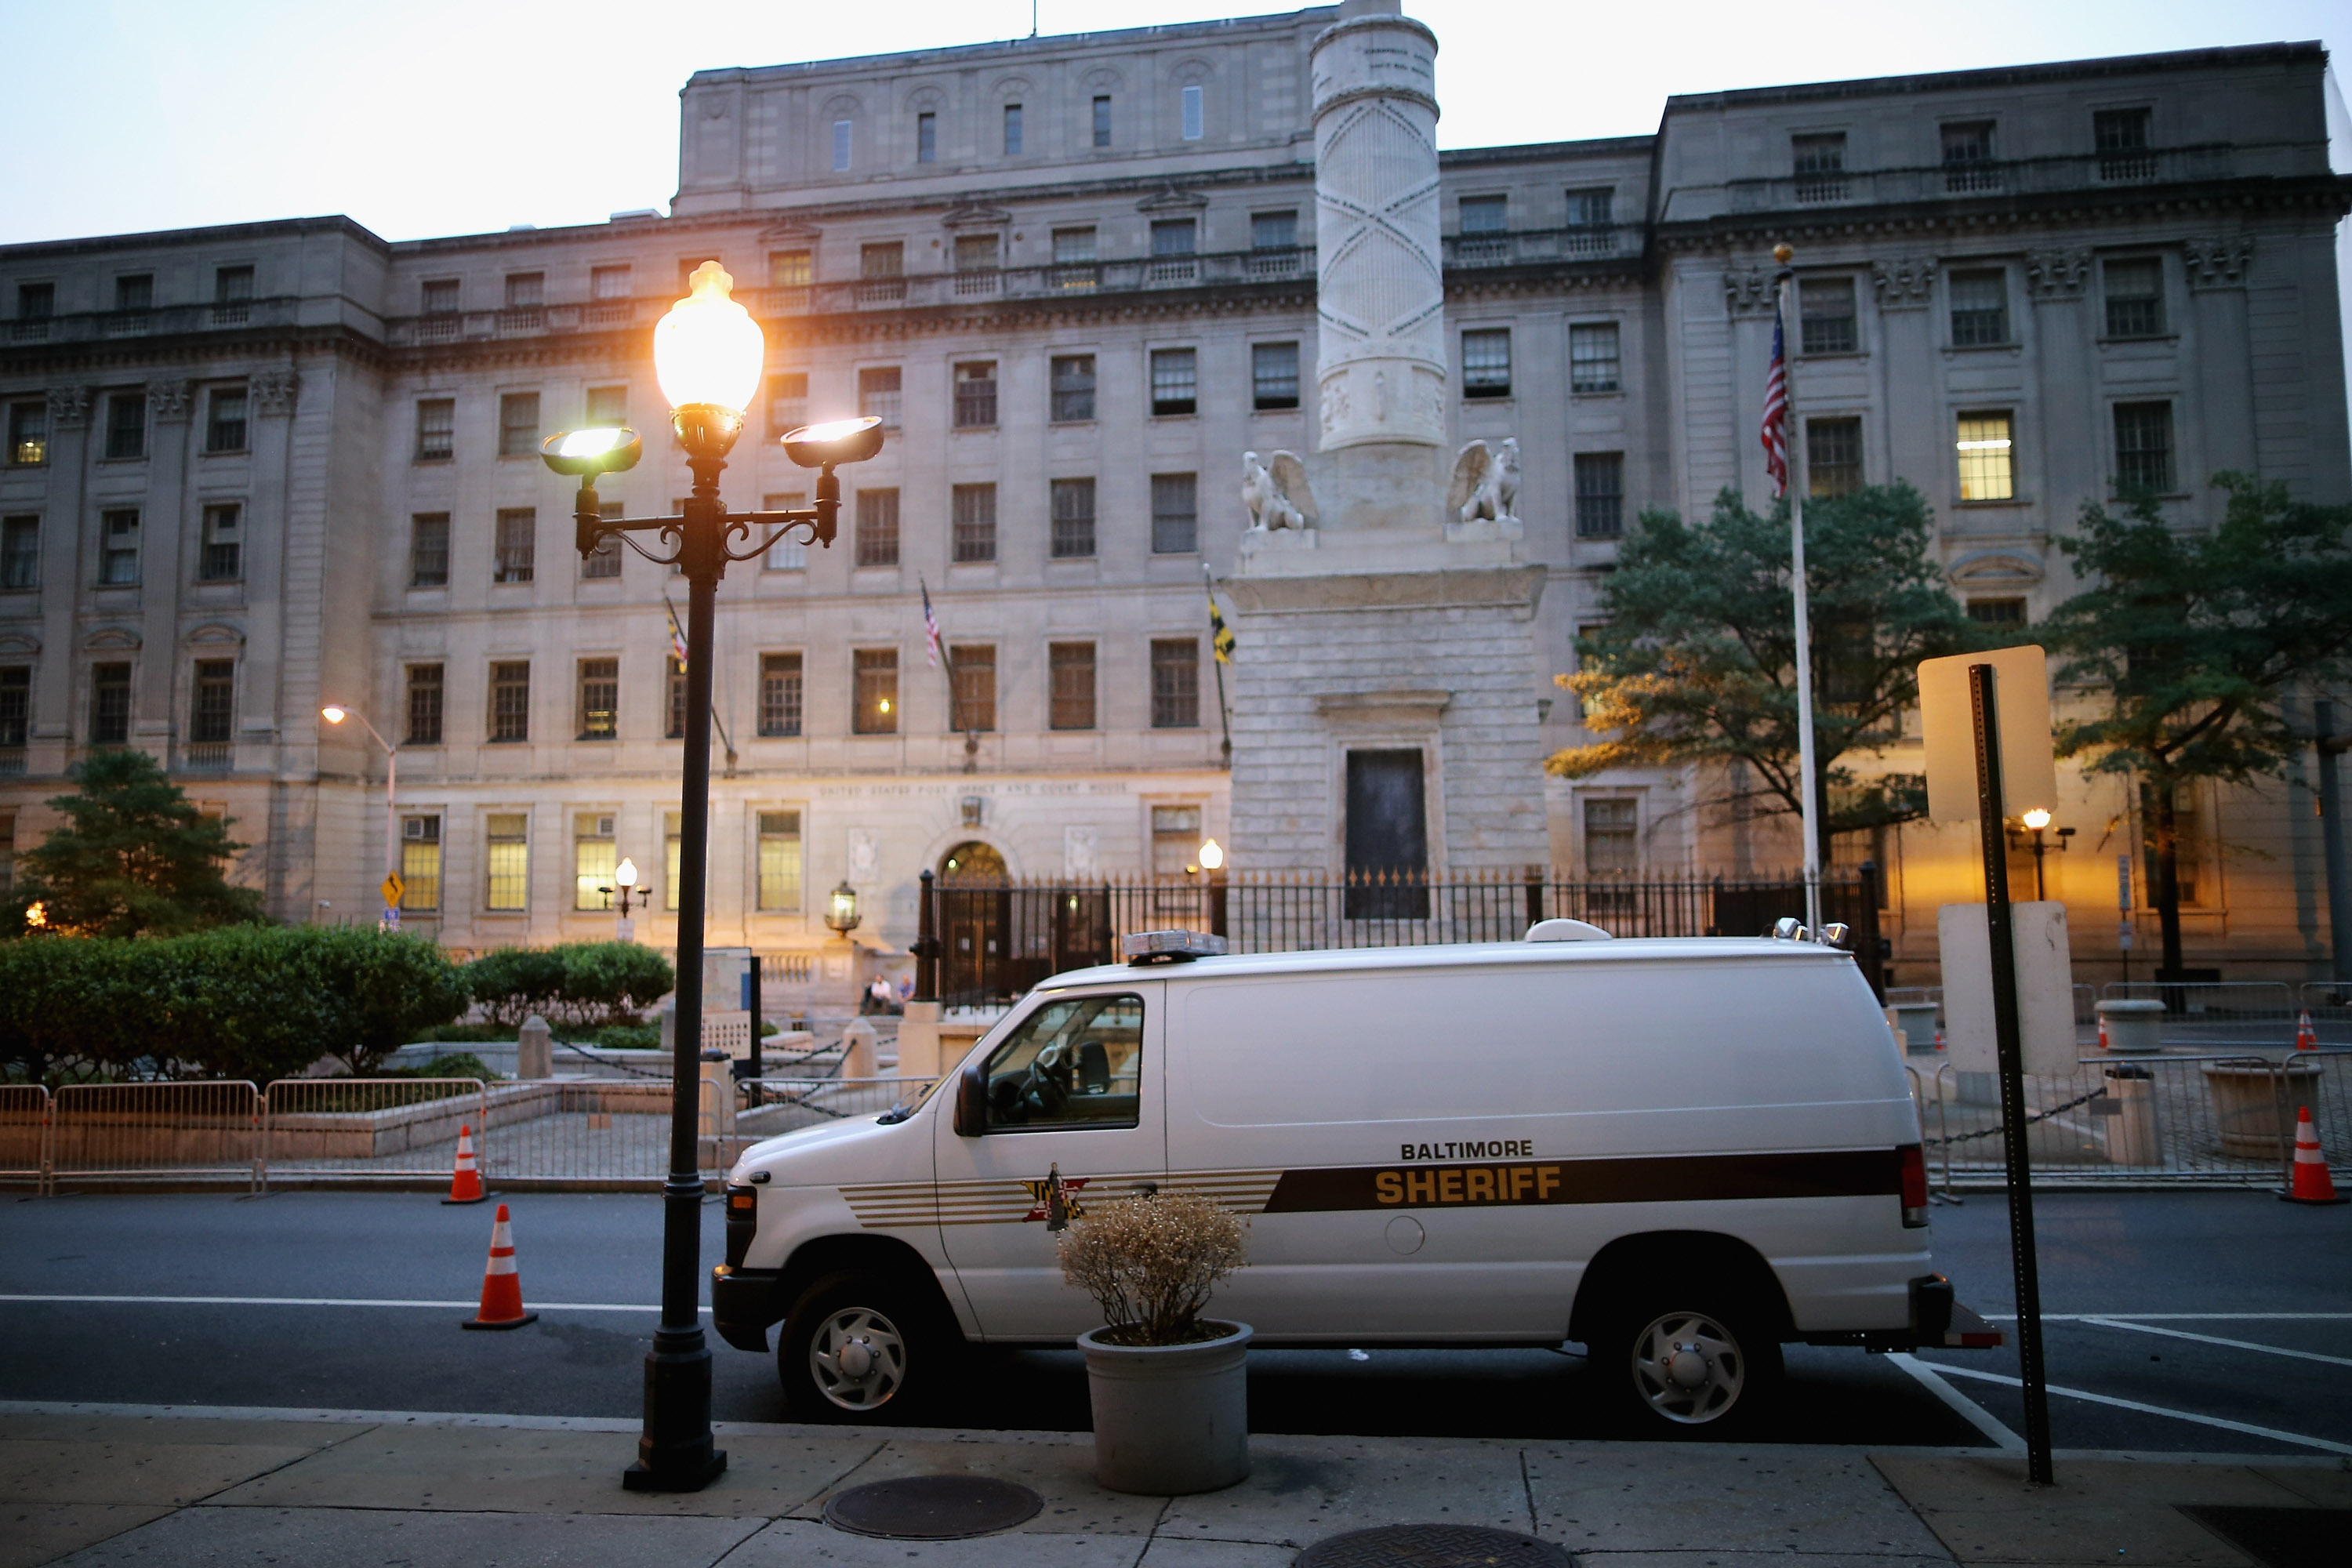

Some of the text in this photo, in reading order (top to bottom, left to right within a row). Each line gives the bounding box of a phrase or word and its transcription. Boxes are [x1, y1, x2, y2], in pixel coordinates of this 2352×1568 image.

[871, 785, 910, 795] STATES
[1401, 1140, 1533, 1160] BALTIMORE
[1375, 1166, 1561, 1204] SHERIFF
